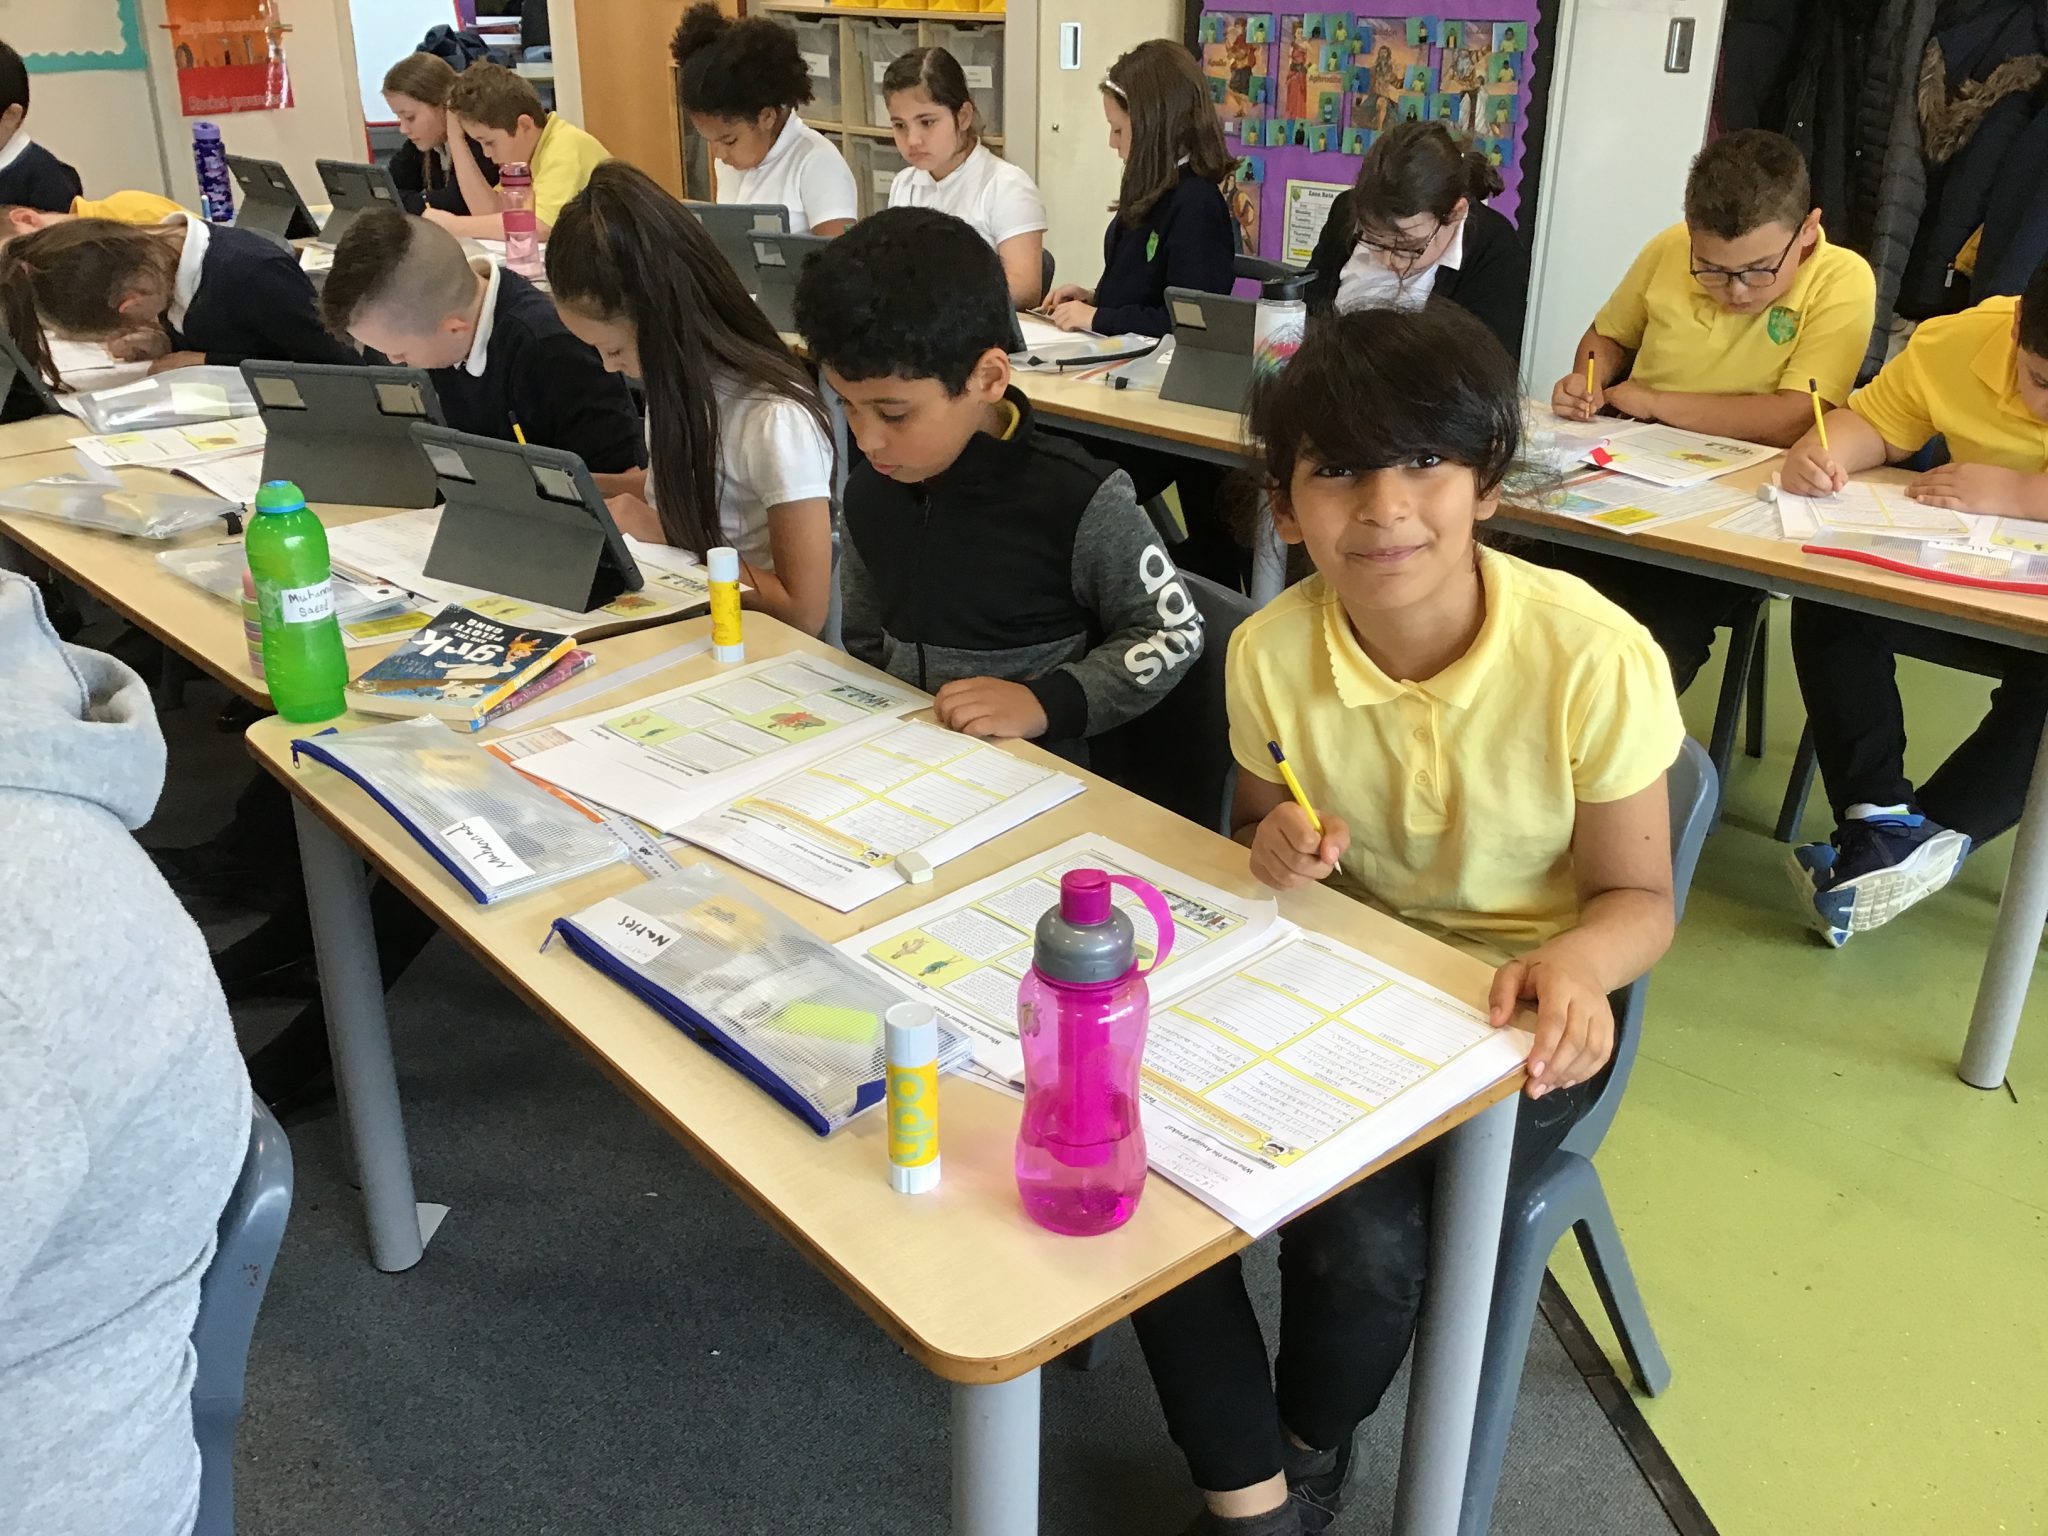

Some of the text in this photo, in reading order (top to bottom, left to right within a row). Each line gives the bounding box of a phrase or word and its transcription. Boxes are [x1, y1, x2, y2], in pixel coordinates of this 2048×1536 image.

[449, 621, 504, 641] PELOTTI
[465, 618, 503, 634] GANG
[453, 631, 469, 640] THE
[410, 628, 504, 660] grk
[1237, 1162, 1253, 1175] Who
